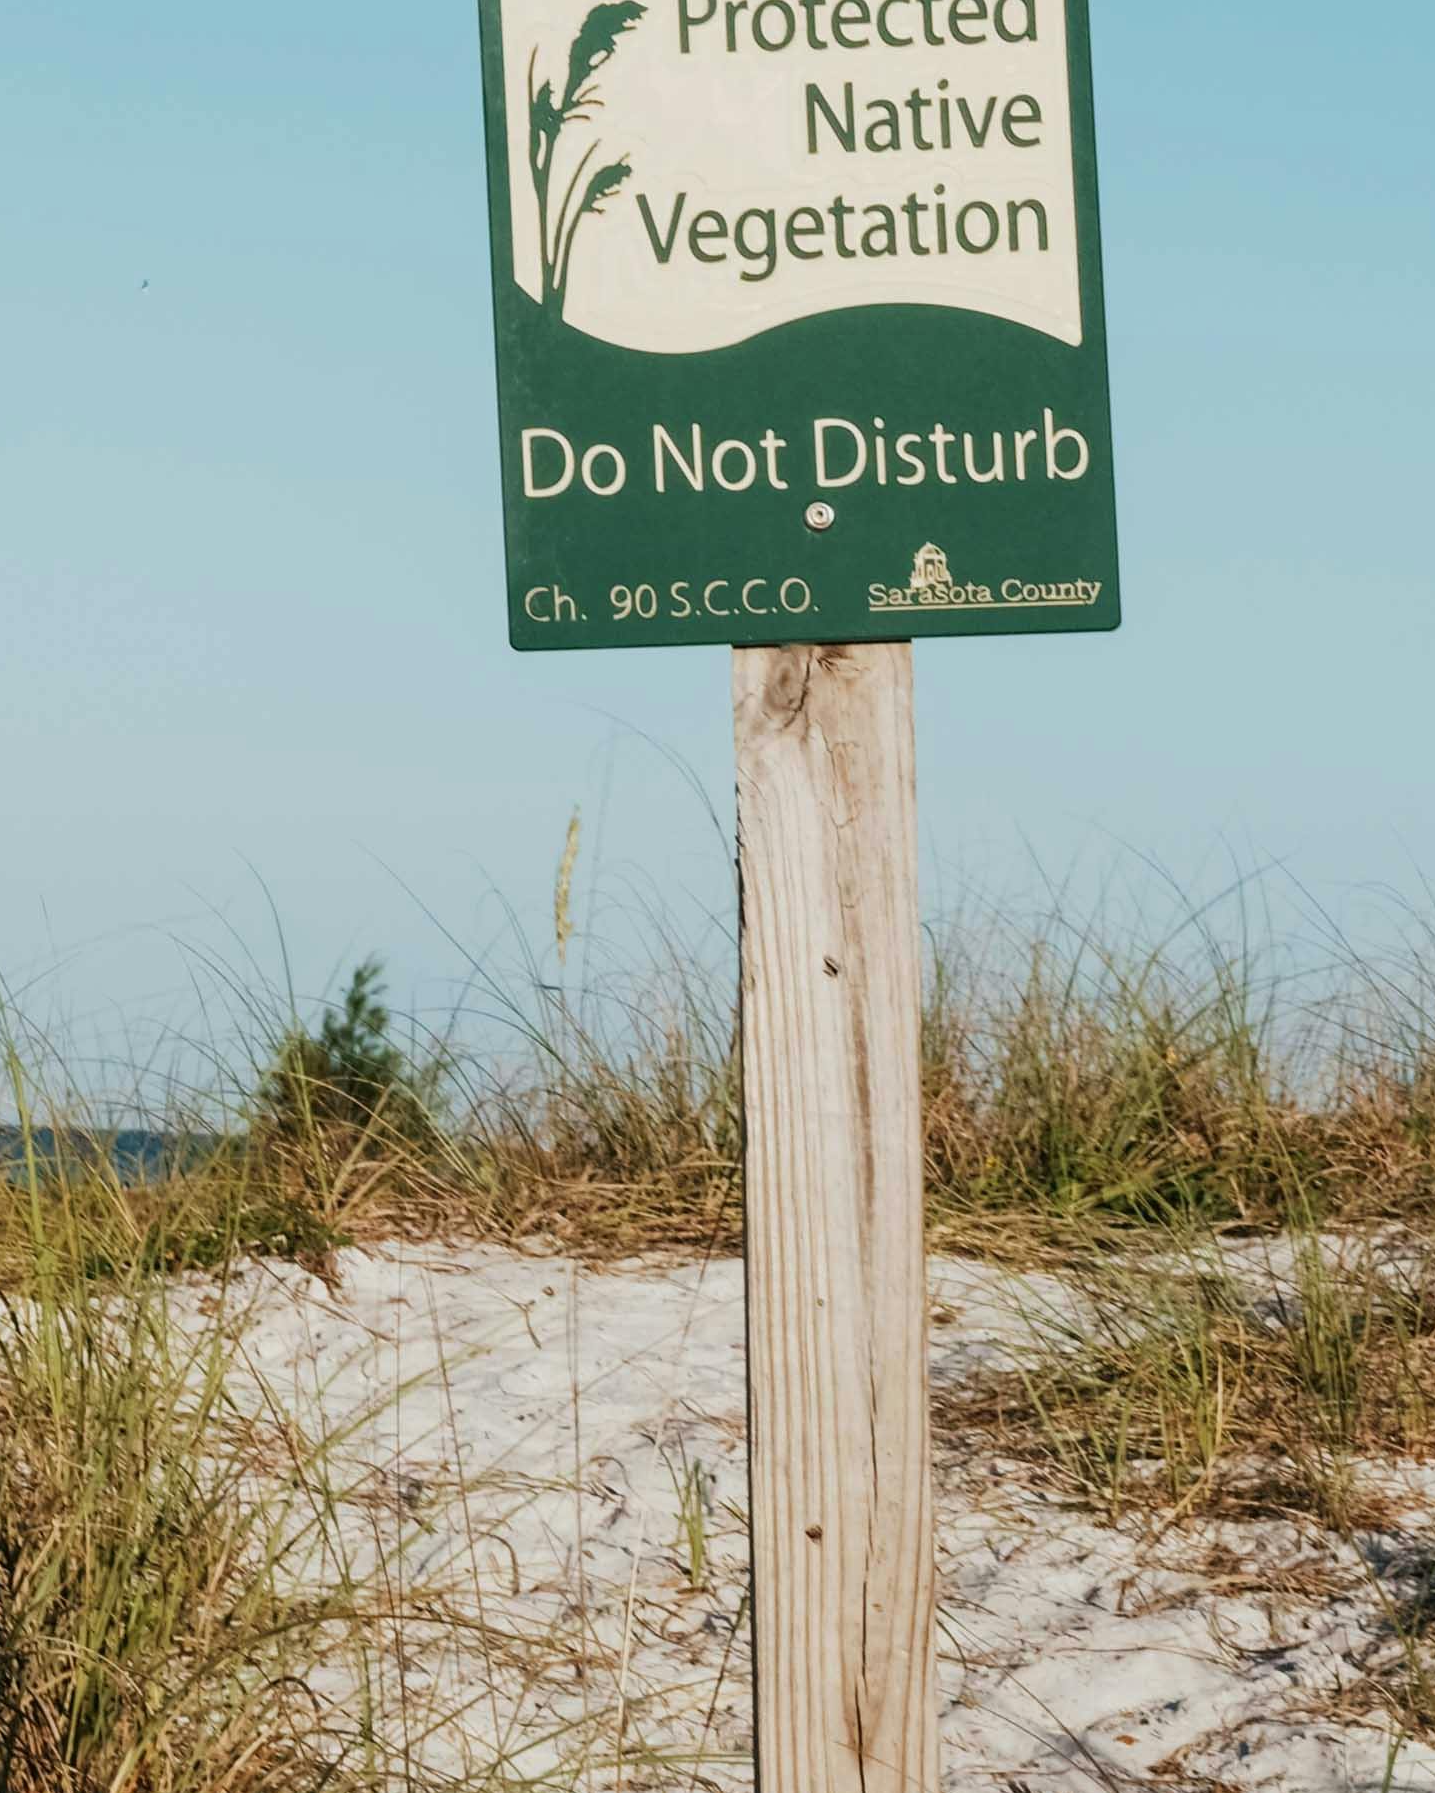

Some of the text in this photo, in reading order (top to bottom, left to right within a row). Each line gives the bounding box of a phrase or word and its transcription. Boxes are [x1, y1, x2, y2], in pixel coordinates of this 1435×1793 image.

[806, 79, 1043, 155] Native
[636, 184, 1049, 282] Vegetation
[520, 407, 1090, 499] Do Not Disturb
[524, 576, 820, 622] Ch. 90 S.C.C.O.
[867, 577, 1103, 607] Sarasota County
